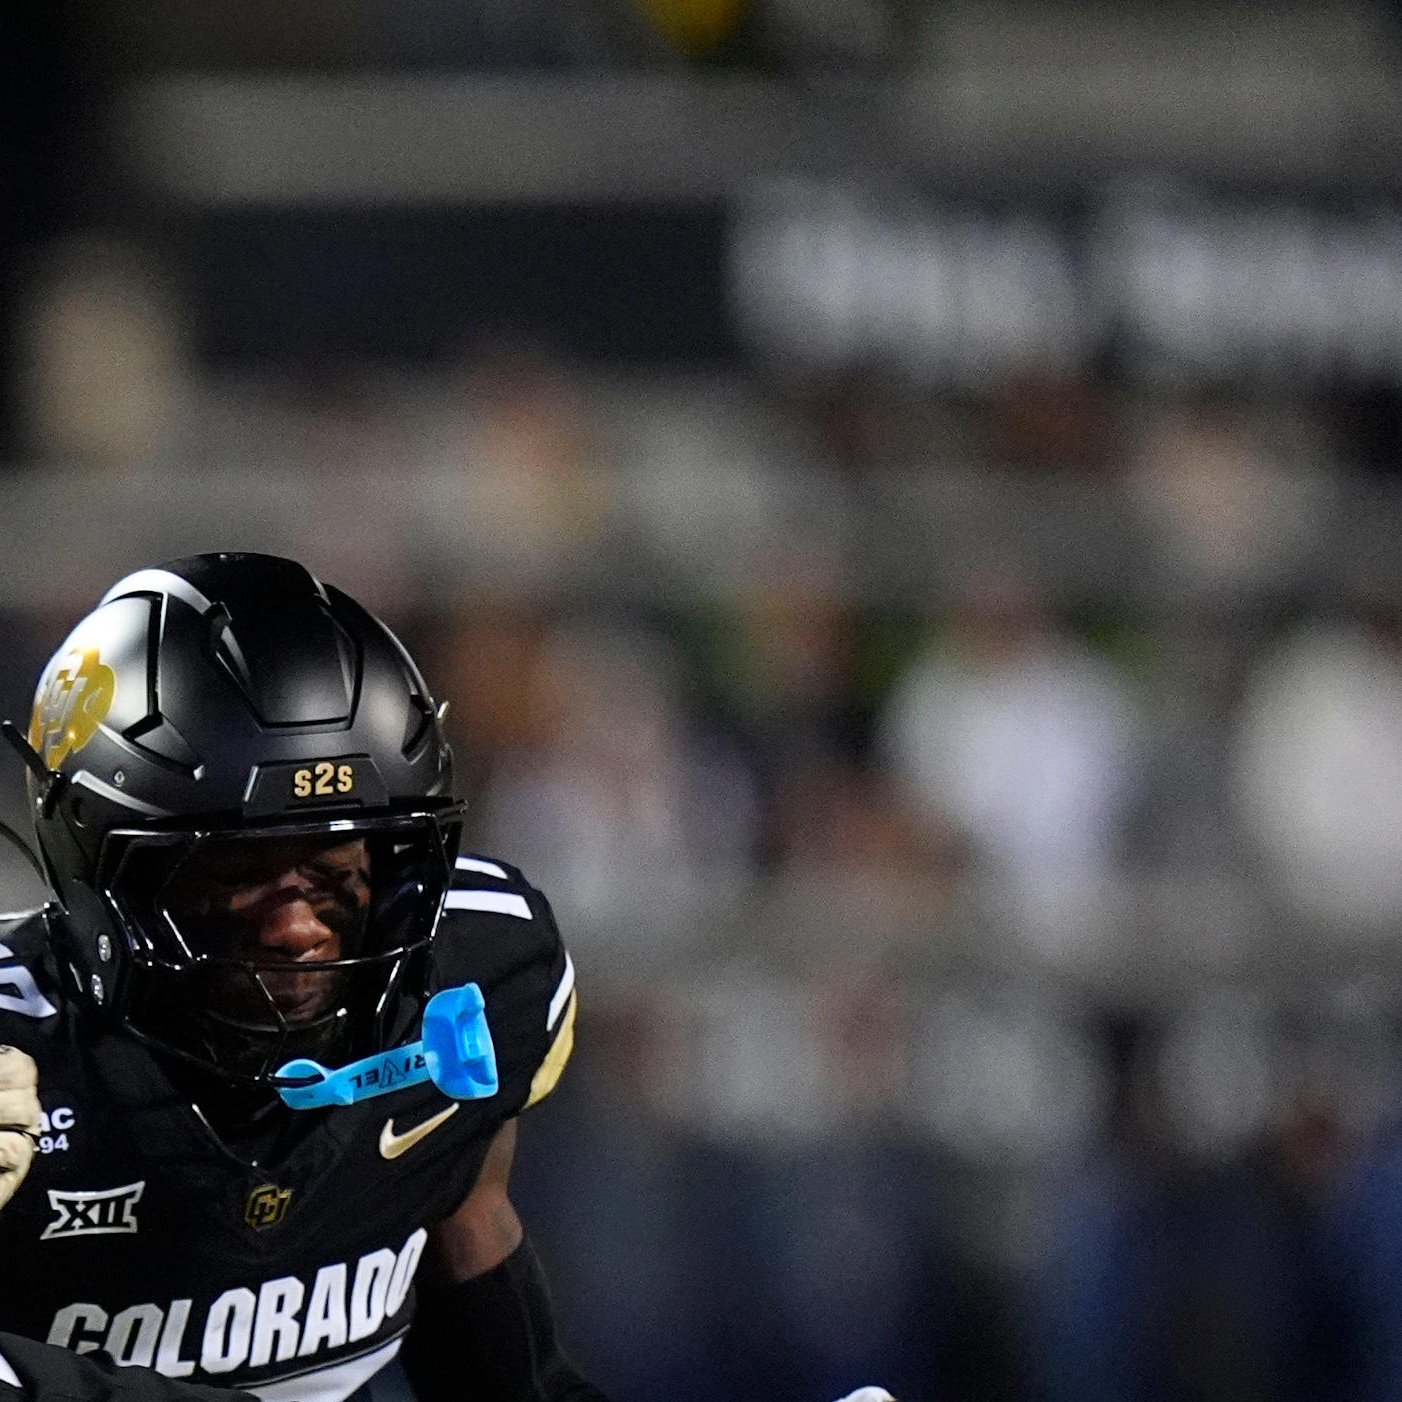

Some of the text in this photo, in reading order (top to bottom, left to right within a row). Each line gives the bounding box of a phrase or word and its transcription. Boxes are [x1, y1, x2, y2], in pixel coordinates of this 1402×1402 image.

[294, 762, 353, 798] S2S
[44, 1184, 143, 1238] XII
[46, 1227, 428, 1379] COLORADO
